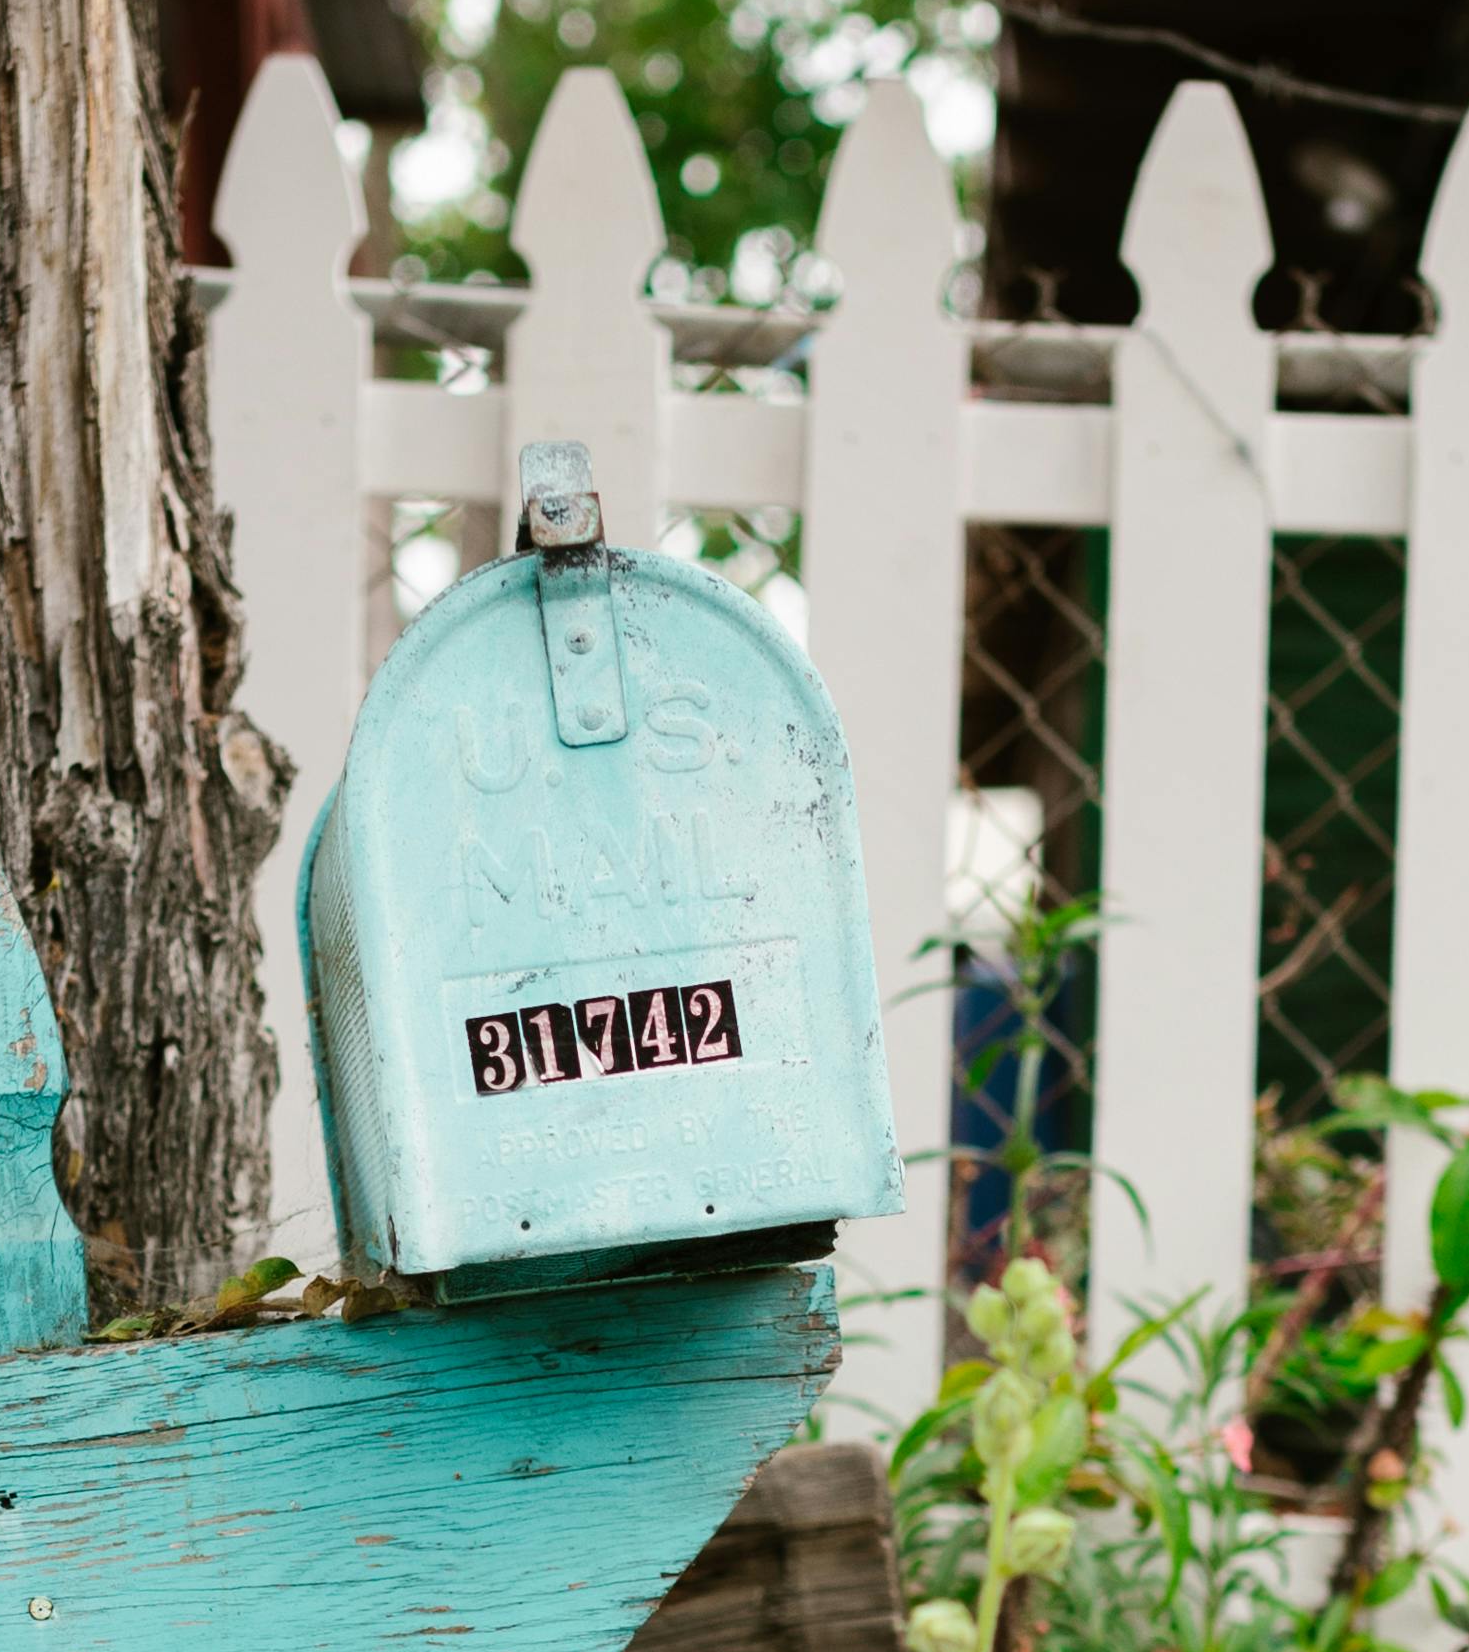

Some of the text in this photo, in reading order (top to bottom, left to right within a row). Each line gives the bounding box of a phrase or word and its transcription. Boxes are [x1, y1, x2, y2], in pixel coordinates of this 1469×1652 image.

[642, 679, 743, 774] S.
[458, 806, 758, 928] MAIL
[479, 987, 729, 1091] 31742
[476, 1102, 812, 1170] APPROVED BY THE
[461, 1155, 838, 1228] POSTMASTER GENERAL
